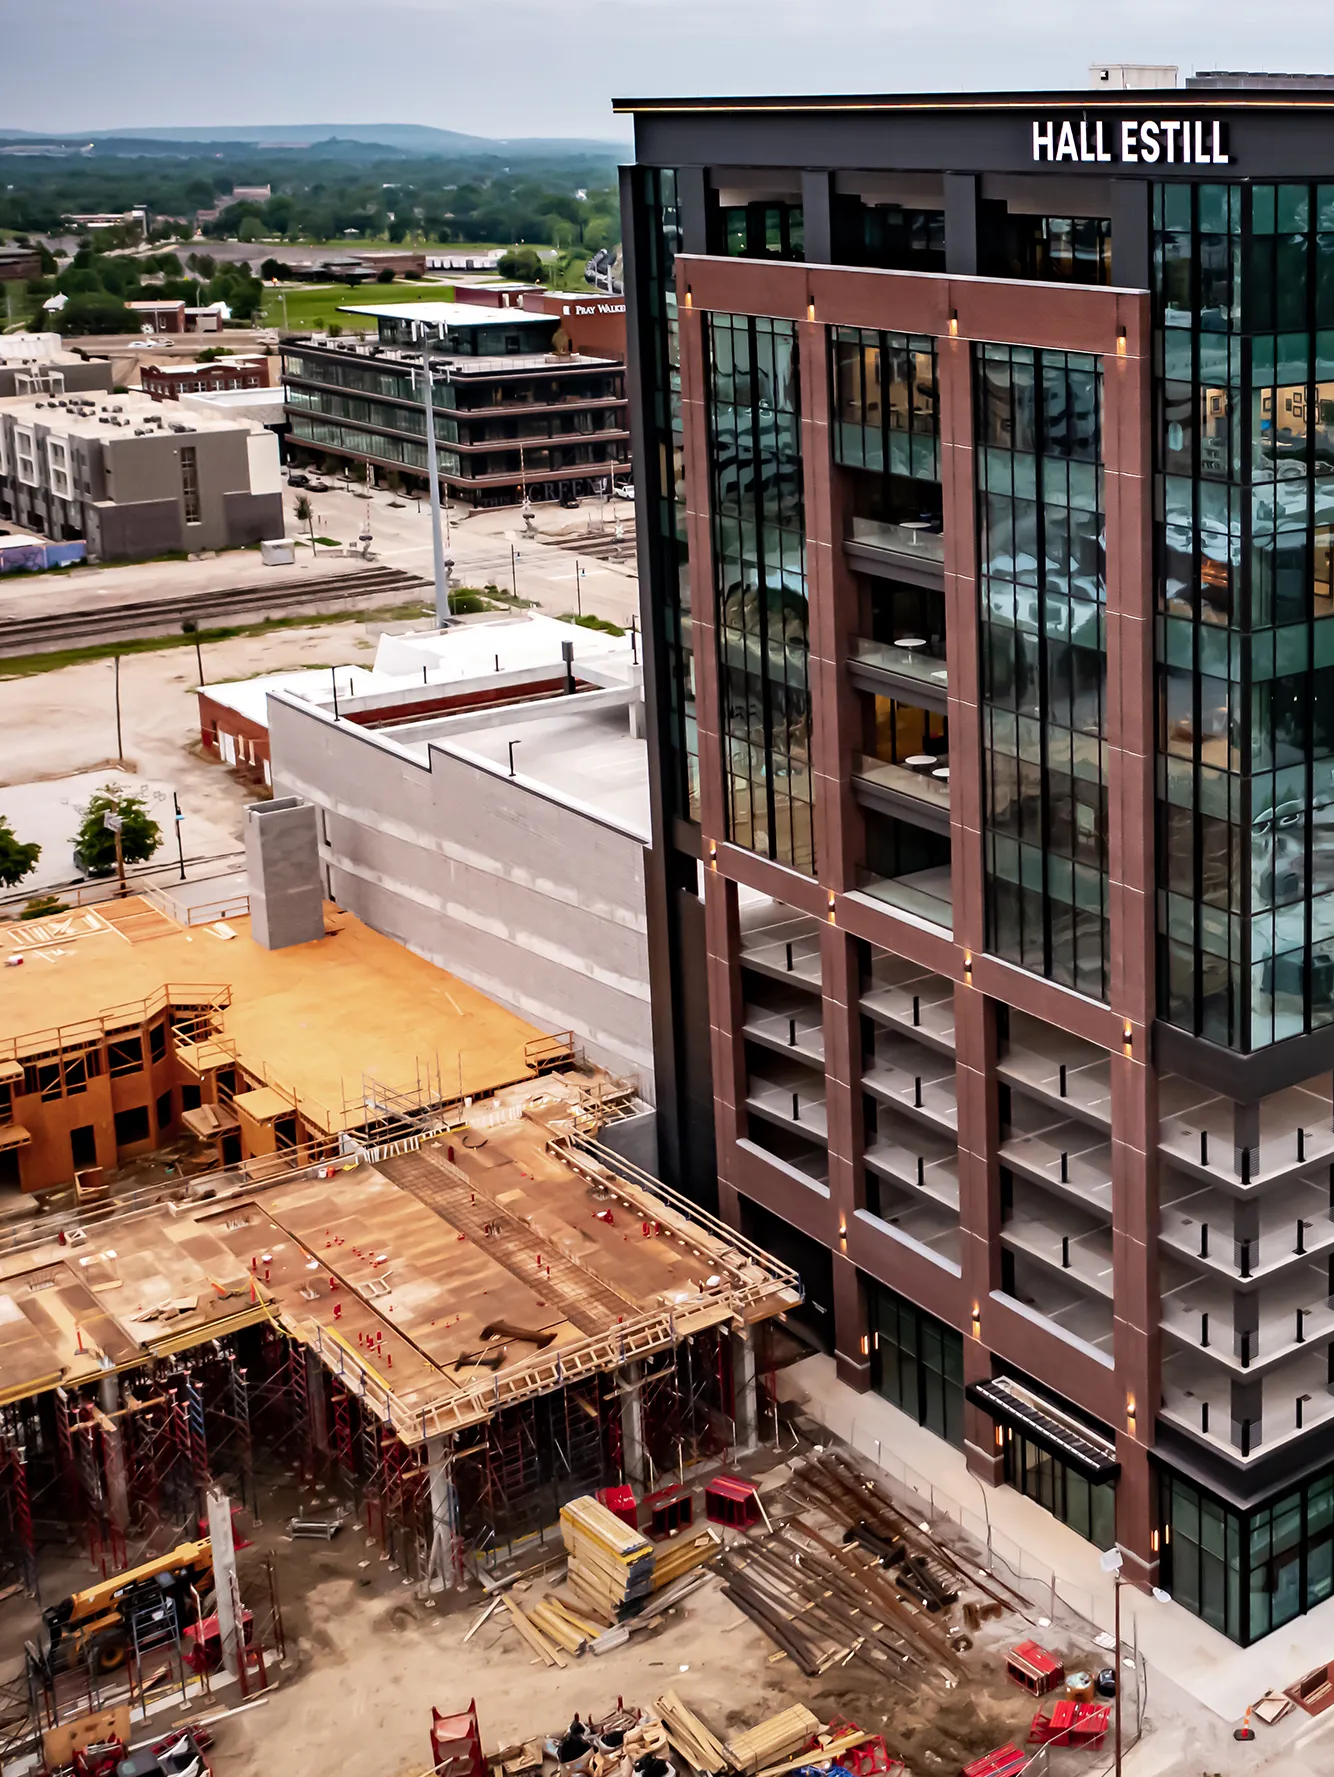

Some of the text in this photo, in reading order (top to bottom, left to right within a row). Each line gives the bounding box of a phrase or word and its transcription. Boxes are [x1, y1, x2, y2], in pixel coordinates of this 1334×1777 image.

[1032, 120, 1229, 164] HALL ESTILL
[575, 304, 626, 315] PRAY WALKE
